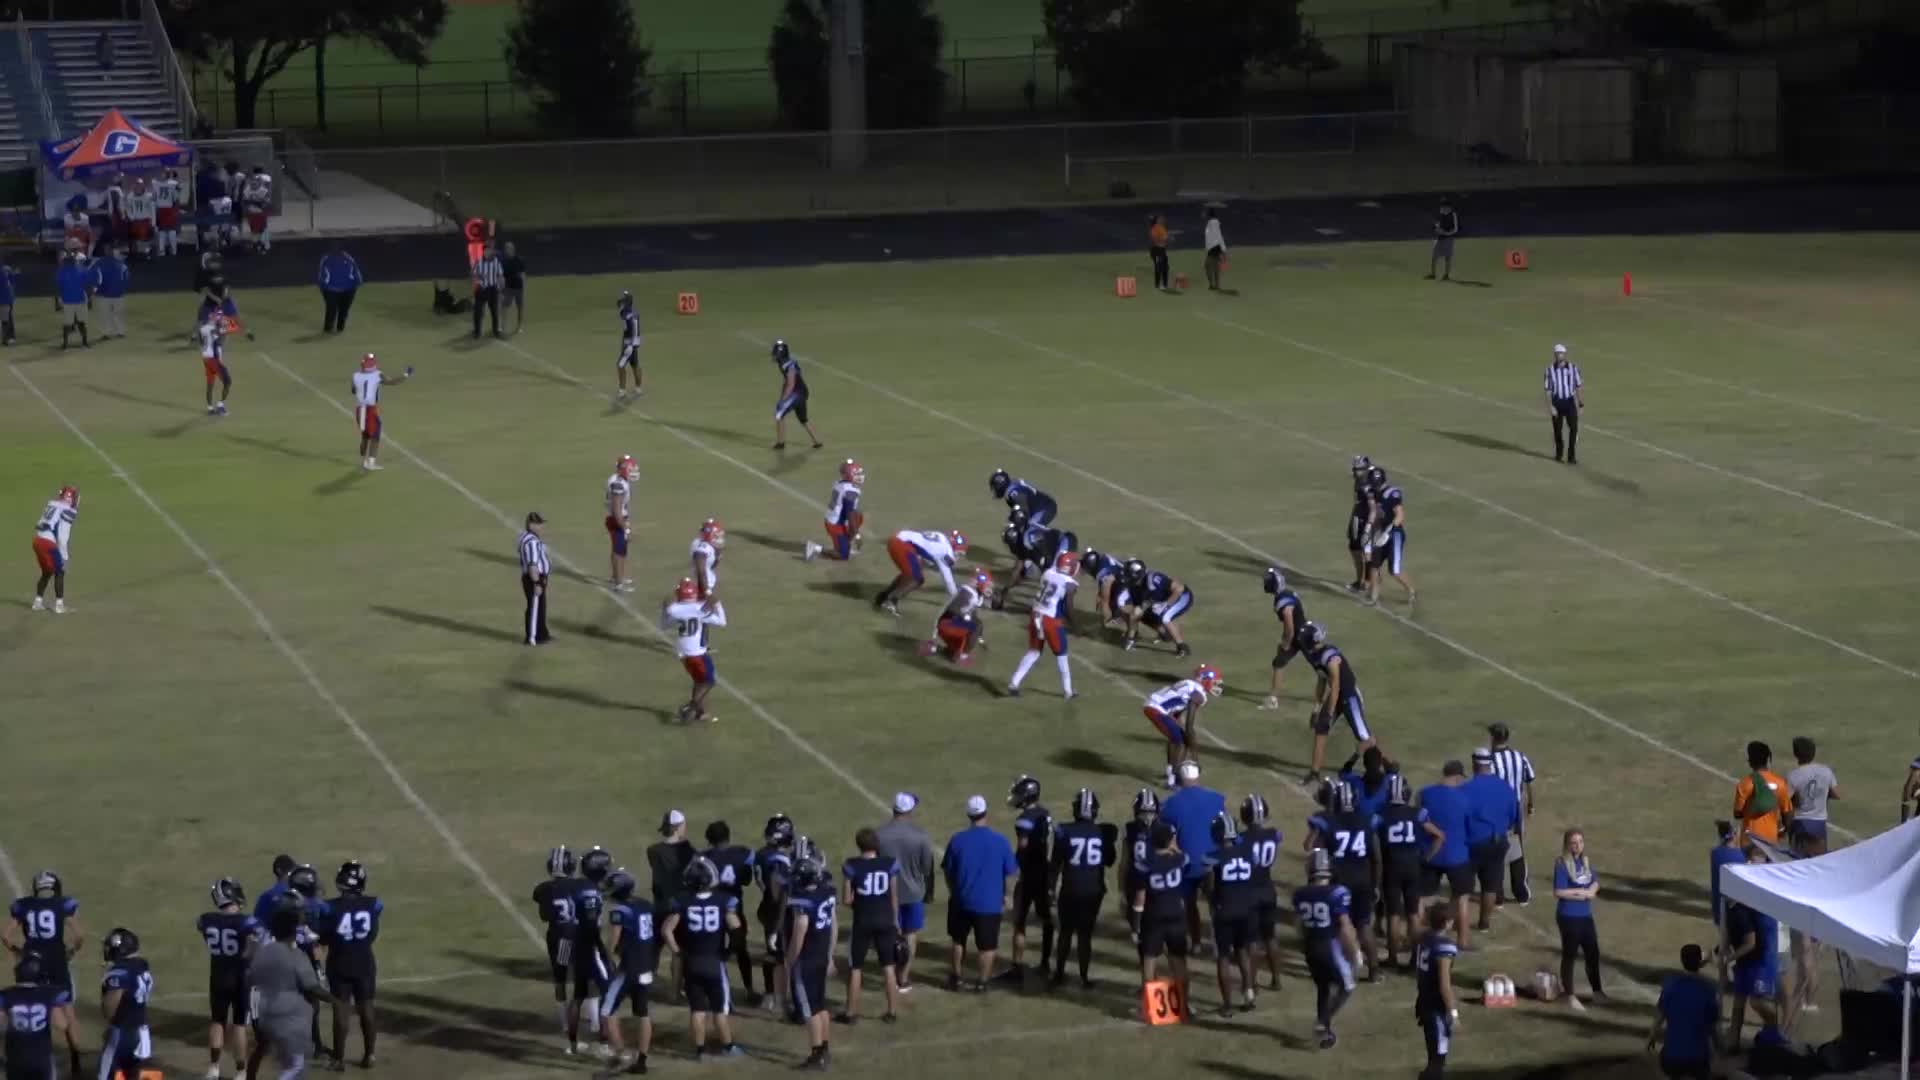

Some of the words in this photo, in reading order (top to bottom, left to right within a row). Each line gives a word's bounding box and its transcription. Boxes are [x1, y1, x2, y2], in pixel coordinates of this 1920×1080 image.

[680, 295, 696, 311] 20
[1333, 830, 1367, 858] 74
[1388, 820, 1416, 843] 21
[1069, 837, 1103, 866] 76
[1252, 839, 1276, 868] 10
[1222, 857, 1251, 881] 25
[26, 909, 57, 940] 19
[337, 910, 372, 942] 43
[687, 905, 720, 933] 58
[1299, 901, 1331, 928] 29
[205, 927, 239, 956] 26
[1153, 985, 1181, 1019] 30
[11, 1002, 48, 1032] 62
